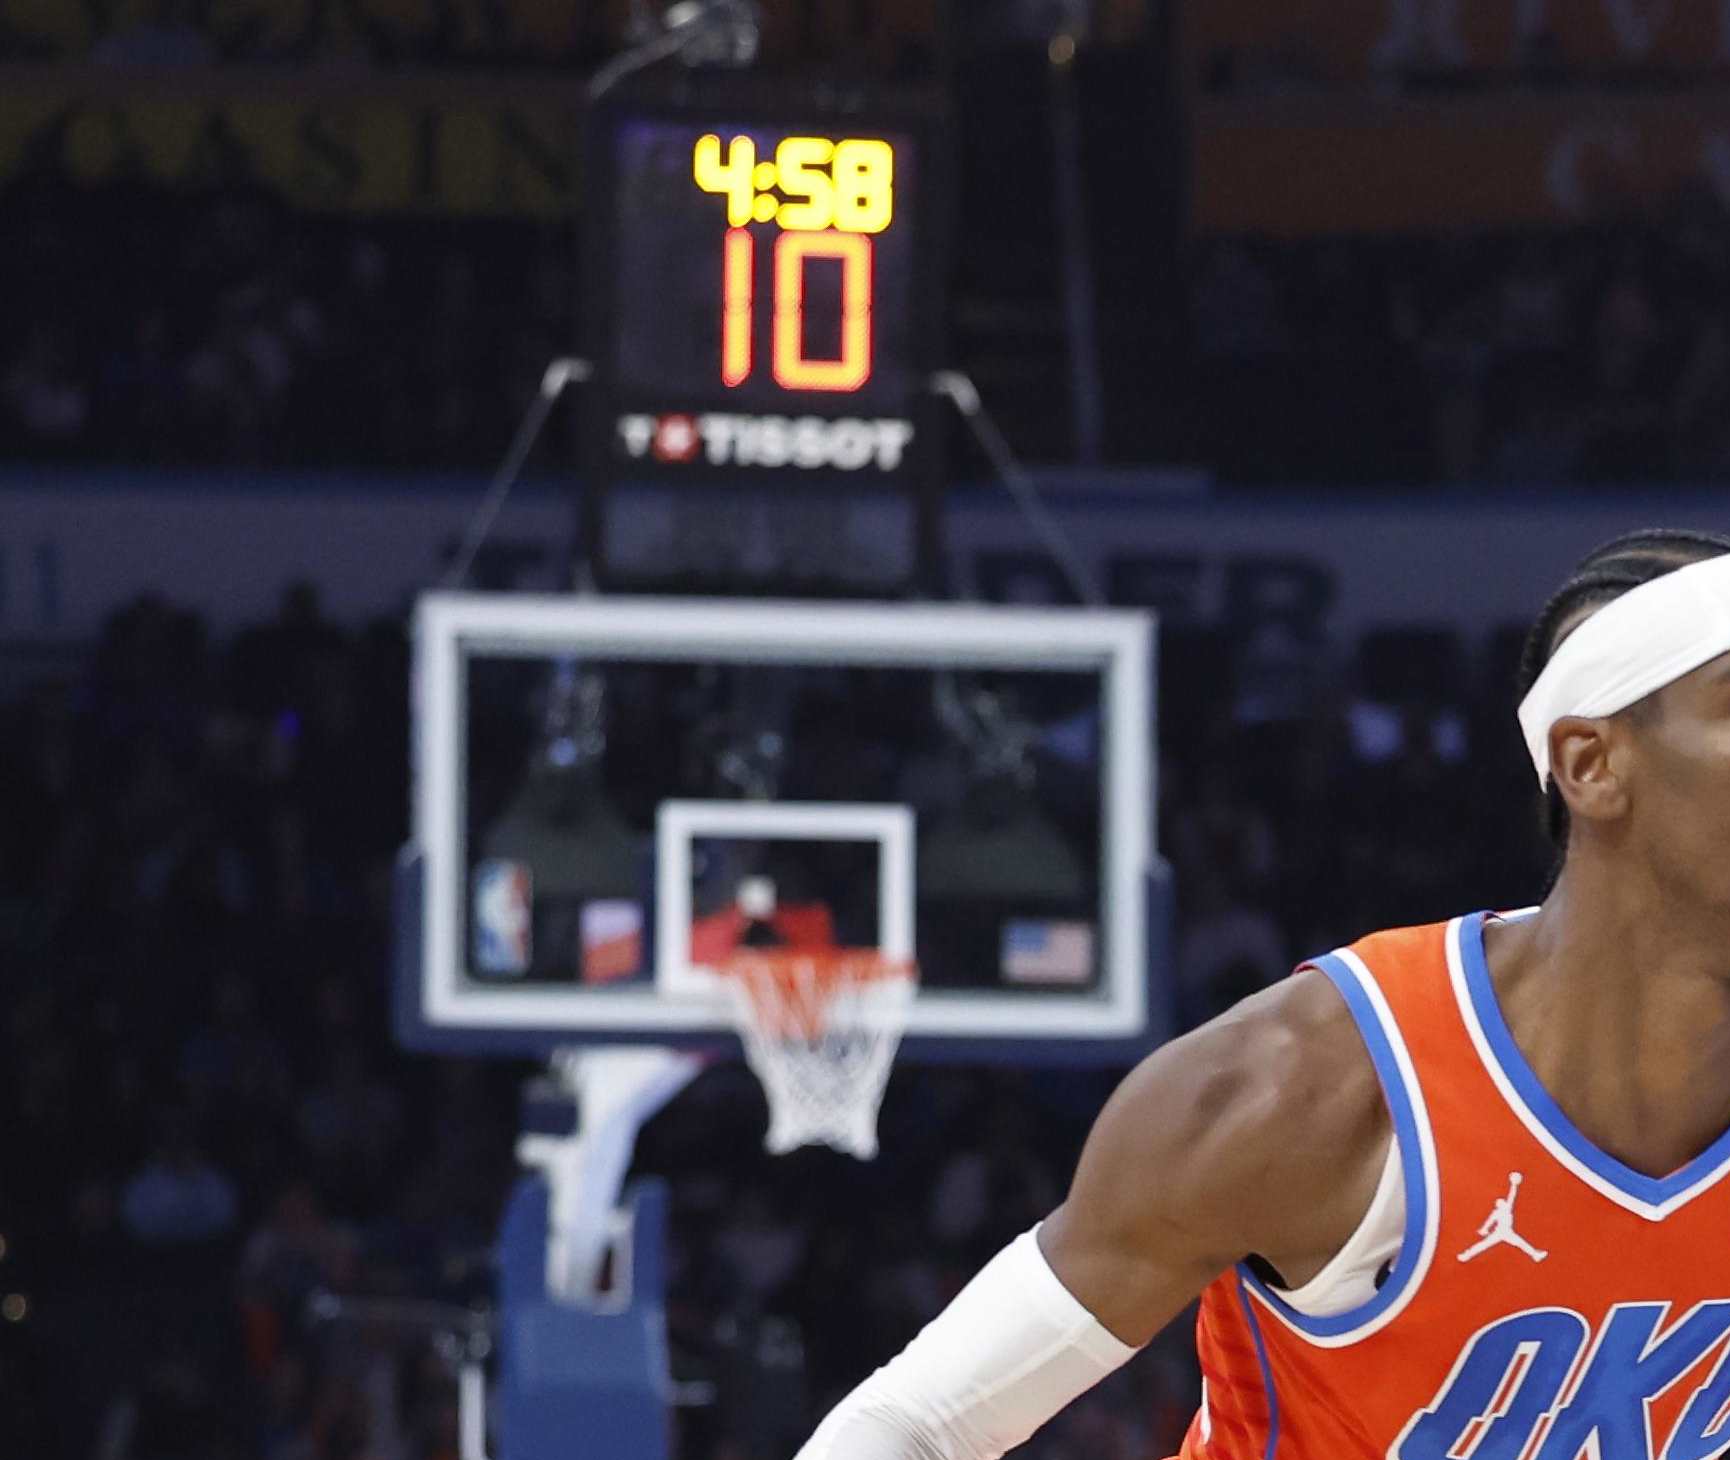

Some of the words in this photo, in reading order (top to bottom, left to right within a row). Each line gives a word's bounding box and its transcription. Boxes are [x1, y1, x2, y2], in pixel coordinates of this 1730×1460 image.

[694, 134, 894, 233] 4:58
[721, 228, 873, 392] 10
[700, 415, 914, 471] TISSOT
